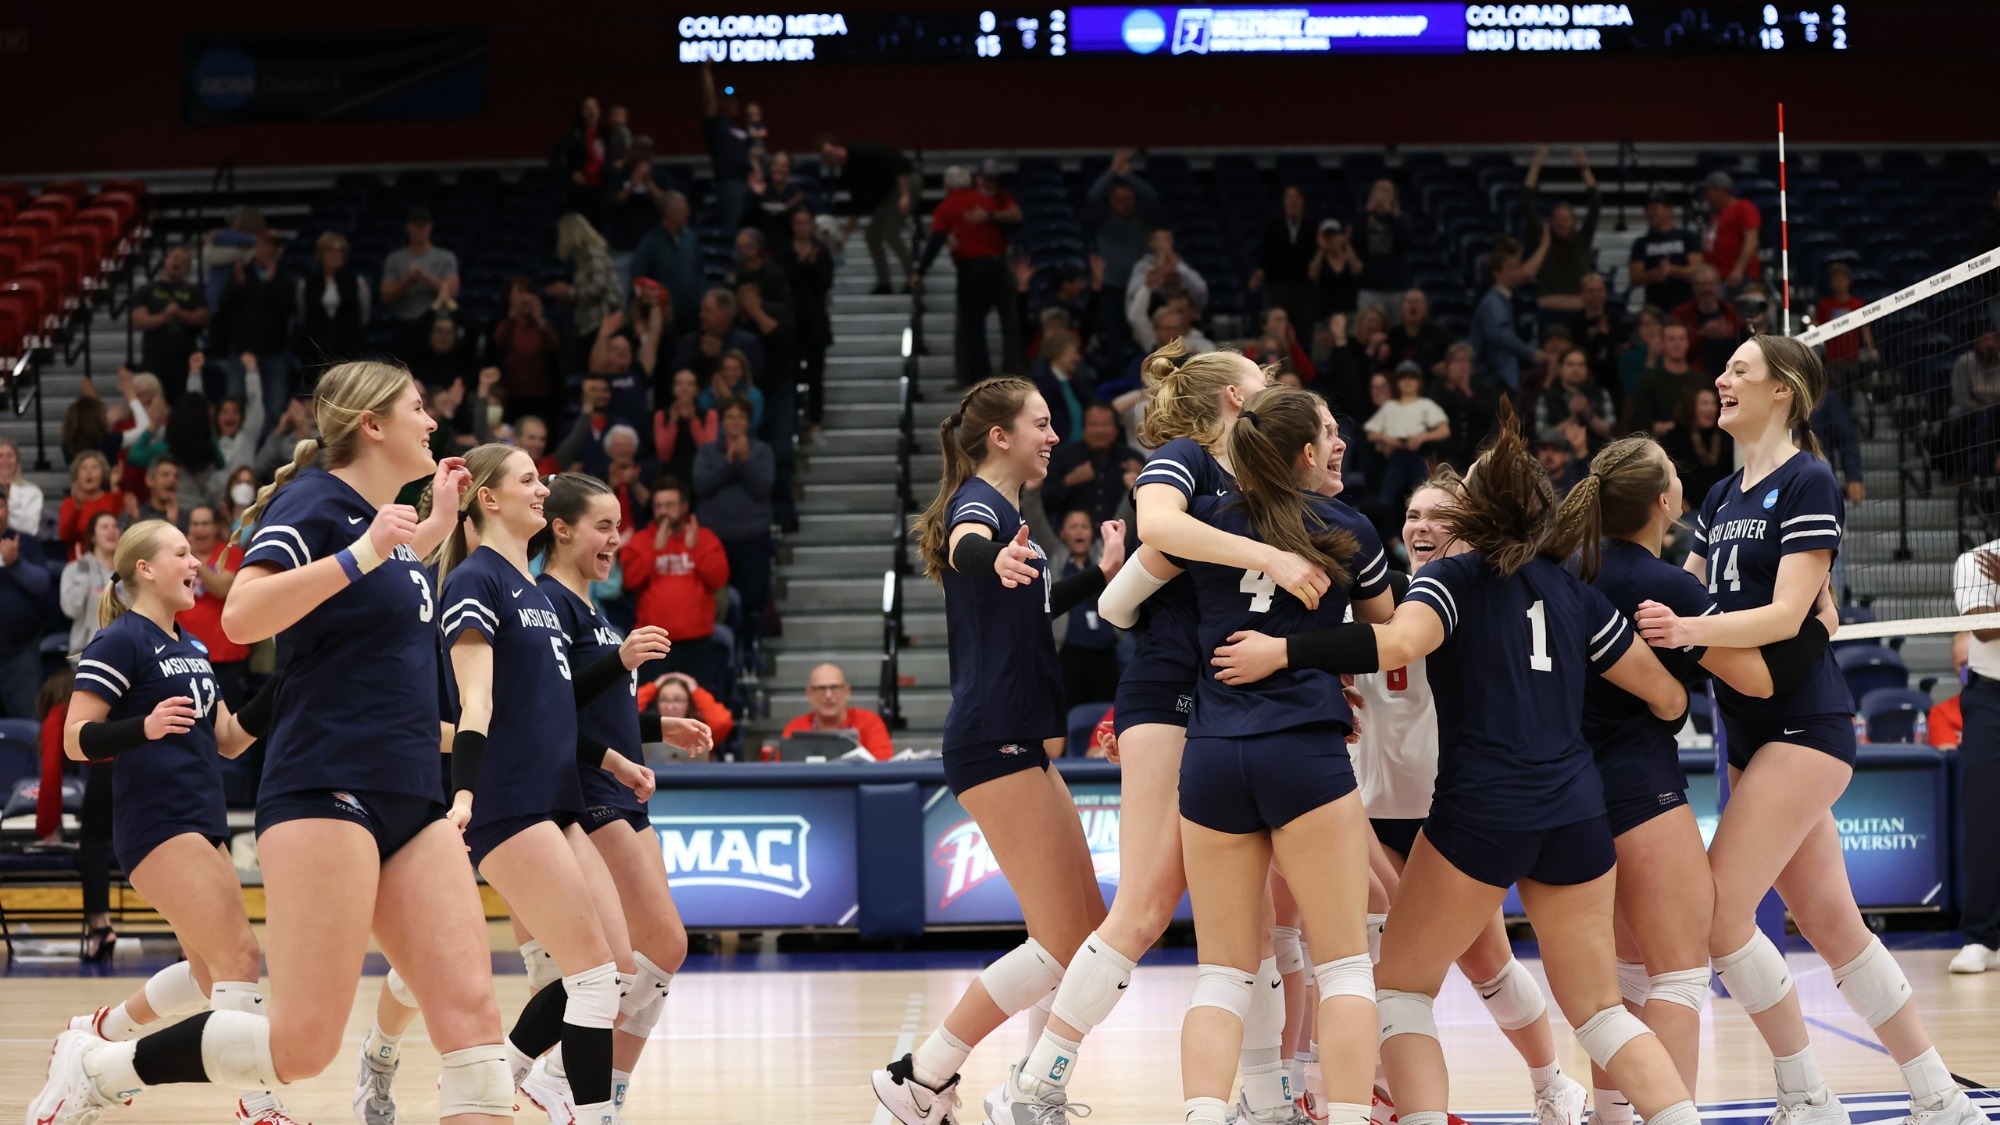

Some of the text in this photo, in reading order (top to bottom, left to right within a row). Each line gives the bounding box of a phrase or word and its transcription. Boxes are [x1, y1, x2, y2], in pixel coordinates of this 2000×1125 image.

[1050, 10, 1066, 31] 2
[1466, 5, 1633, 26] COLORAD MESA
[1832, 4, 1846, 25] 2
[679, 14, 848, 38] COLORAD MESA
[1050, 34, 1066, 55] 2
[1467, 28, 1602, 51] MSU DENVER
[1760, 28, 1784, 49] 15
[1833, 28, 1847, 49] 2
[680, 39, 815, 62] MSU DENVER
[1722, 519, 1767, 541] DENVER
[1708, 544, 1741, 594] 14
[409, 569, 434, 623] 3
[1239, 568, 1277, 613] 4
[517, 608, 545, 628] MSU
[593, 626, 622, 646] MSU
[1527, 599, 1552, 672] 1
[158, 657, 190, 678] MSU
[549, 635, 572, 681] 5
[189, 677, 216, 719] 13
[1840, 834, 1919, 851] IVERSITY
[656, 829, 795, 882] MAC
